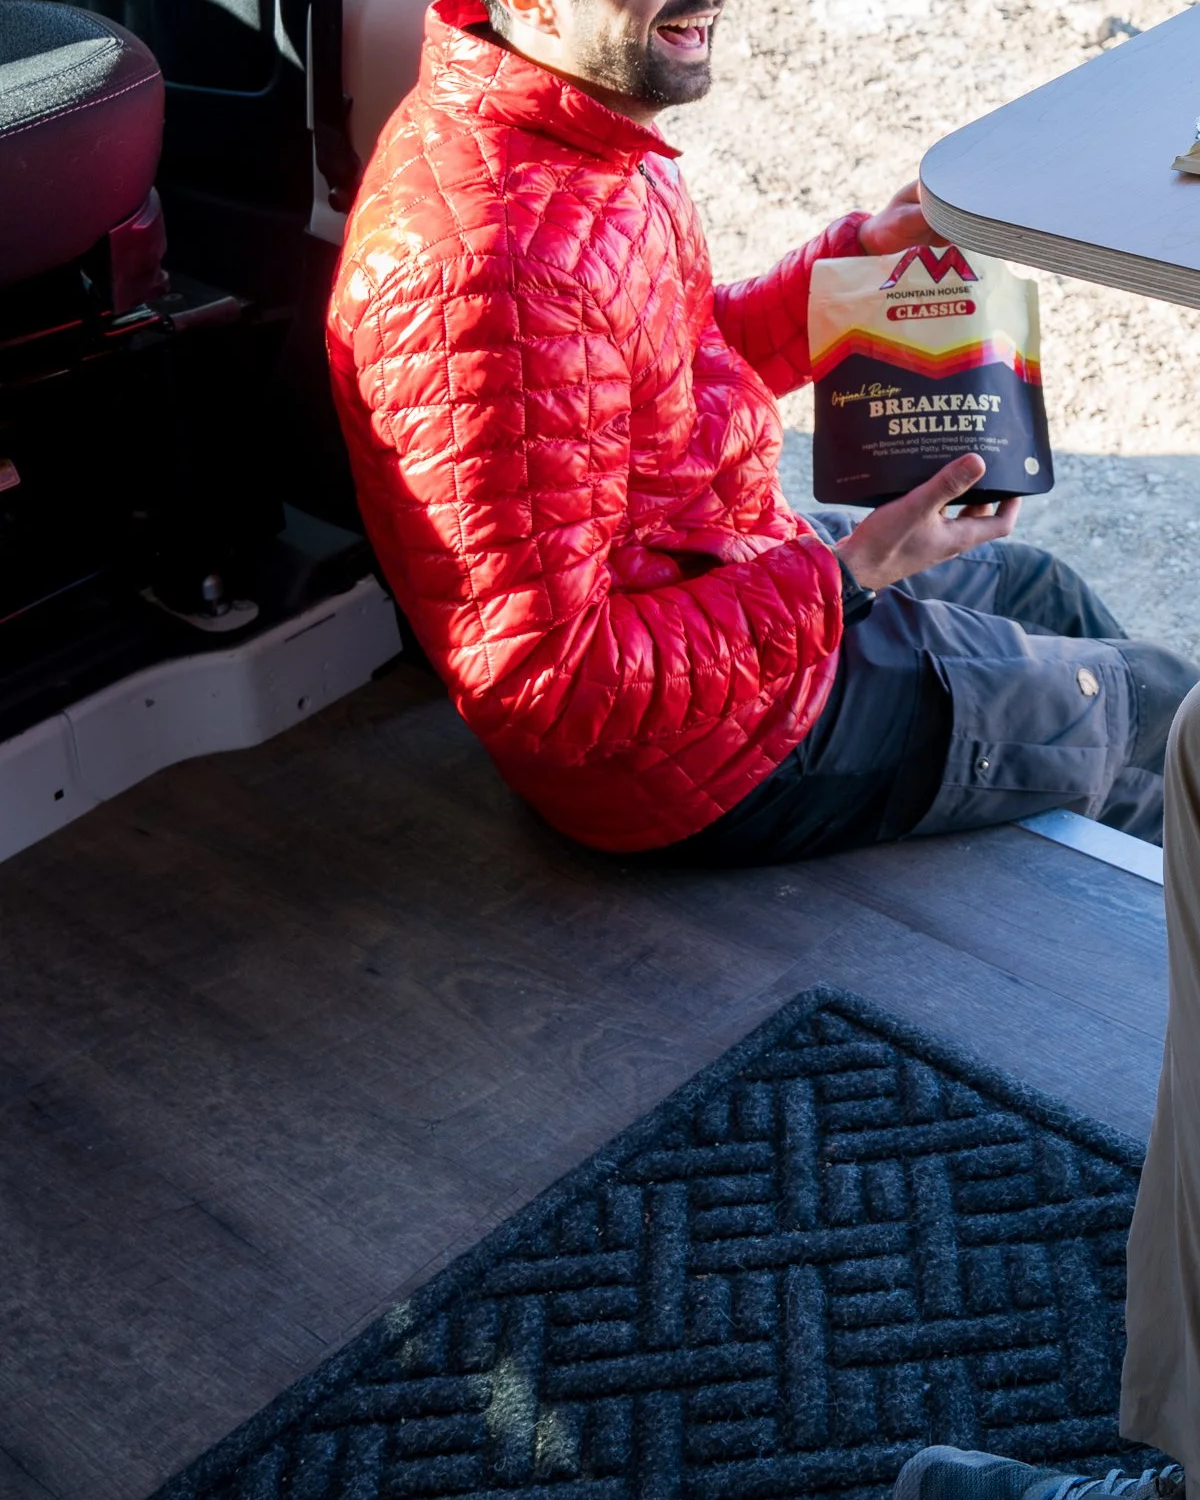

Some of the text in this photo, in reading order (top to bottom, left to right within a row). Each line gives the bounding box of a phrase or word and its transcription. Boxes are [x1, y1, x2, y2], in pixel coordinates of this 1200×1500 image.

[886, 290, 935, 299] MOUNTAIN
[895, 301, 967, 319] CLASSIC
[831, 384, 866, 407] Original
[869, 394, 1001, 418] BREAKFAST
[888, 415, 986, 435] SKILLET
